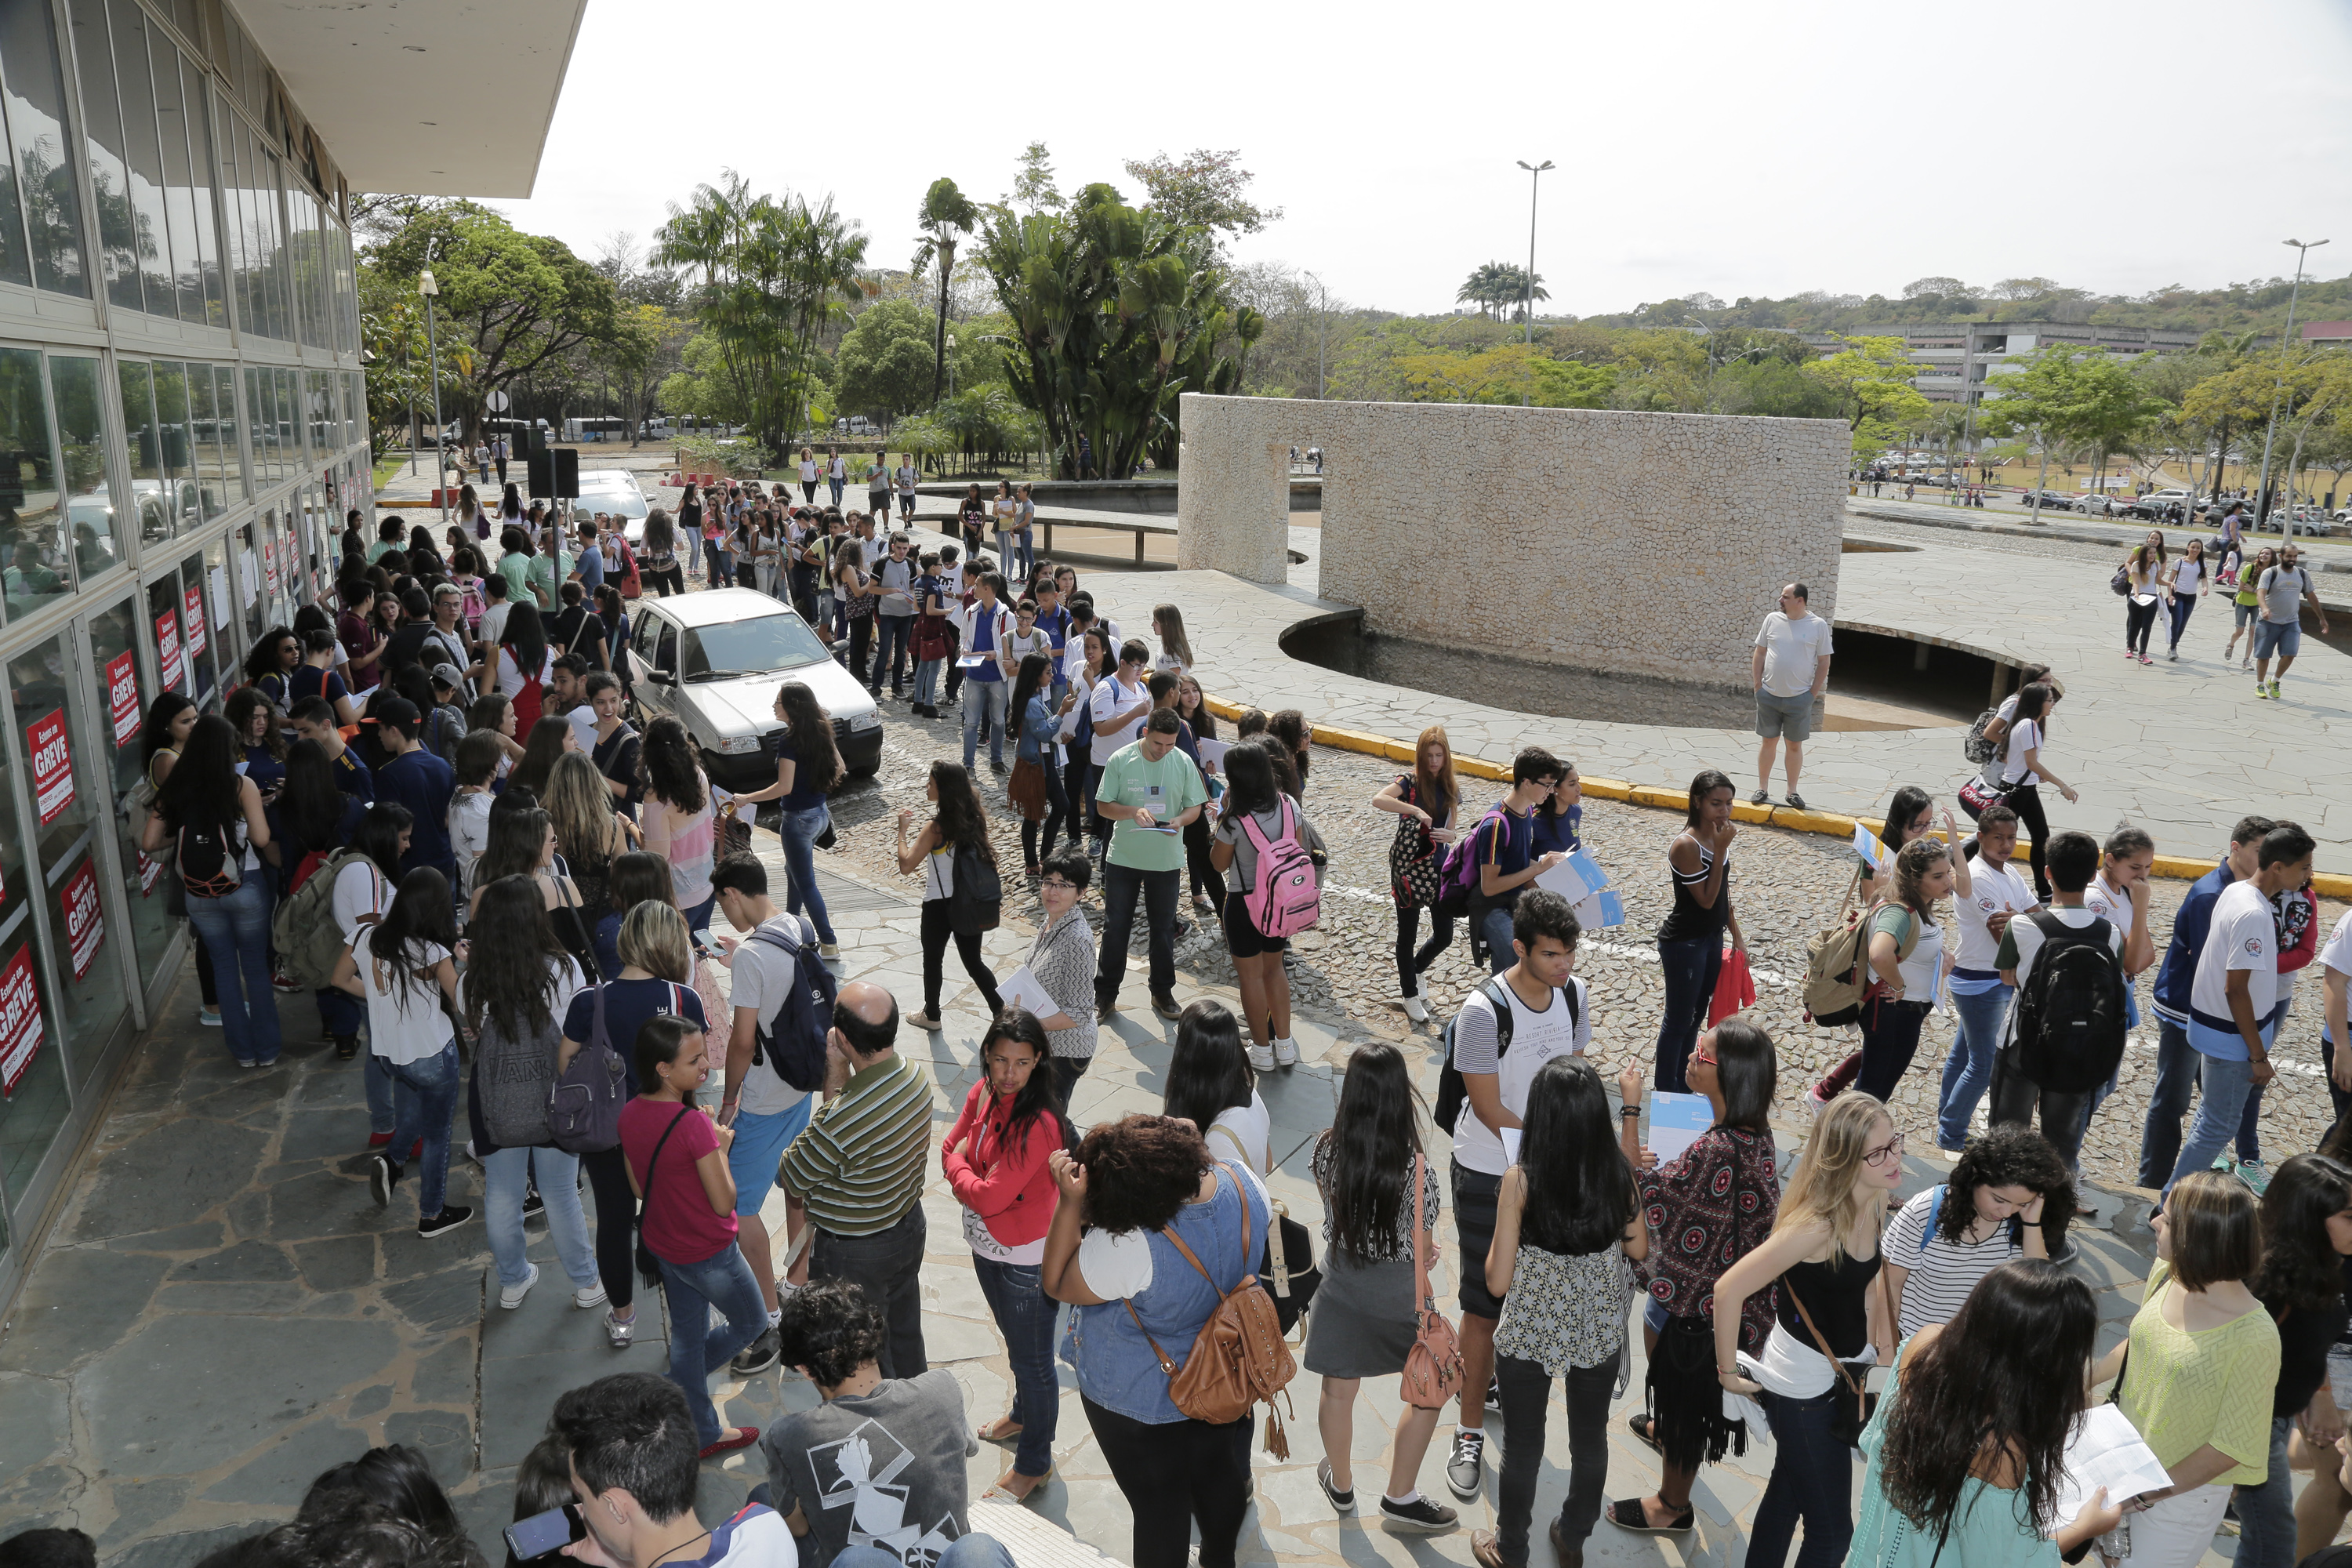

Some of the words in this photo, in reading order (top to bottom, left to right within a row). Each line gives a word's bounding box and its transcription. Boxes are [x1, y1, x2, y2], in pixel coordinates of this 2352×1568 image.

[188, 604, 202, 628] GREVE
[161, 628, 178, 658] GREVE
[113, 672, 135, 708] GREVE
[35, 735, 67, 778] GREVE
[1962, 787, 1991, 807] TOMMY
[69, 882, 97, 936] GREVE
[16, 965, 24, 978] em
[0, 972, 34, 1042] GREVE
[1526, 1031, 1542, 1040] RESORT
[489, 1051, 552, 1085] VANS
